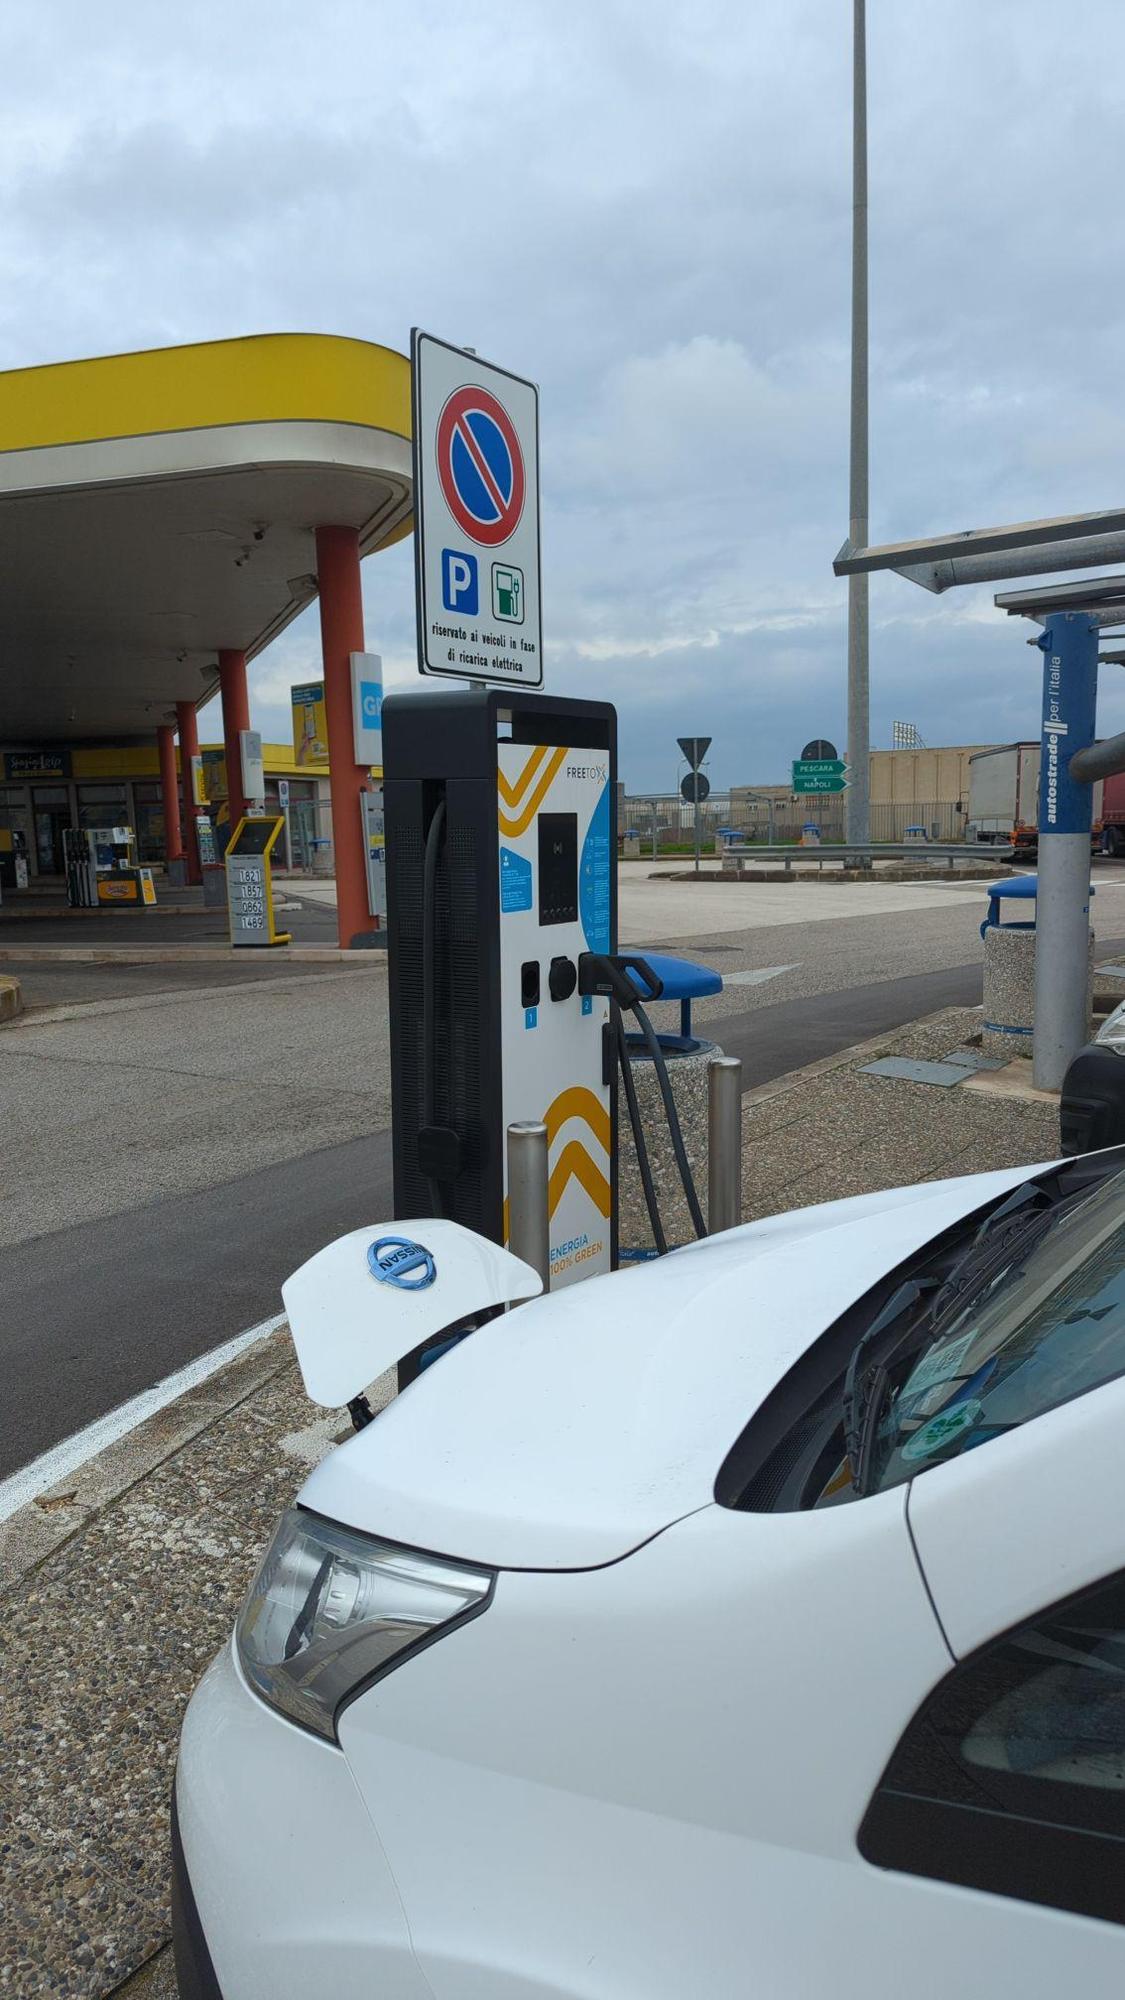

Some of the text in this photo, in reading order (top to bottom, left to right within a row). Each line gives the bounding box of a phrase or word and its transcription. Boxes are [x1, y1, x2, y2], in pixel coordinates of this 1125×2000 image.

[448, 555, 472, 606] P
[432, 622, 536, 652] riservato ai veicoli in fase
[447, 648, 523, 672] di ricarica elettrica
[1047, 656, 1062, 824] autostrade per l'italia
[799, 764, 834, 773] PESCARA
[583, 1000, 590, 1010] 2
[378, 1245, 426, 1271] NISSAN
[549, 1241, 603, 1275] 100% GREEN
[550, 1233, 588, 1261] ENERGIA
